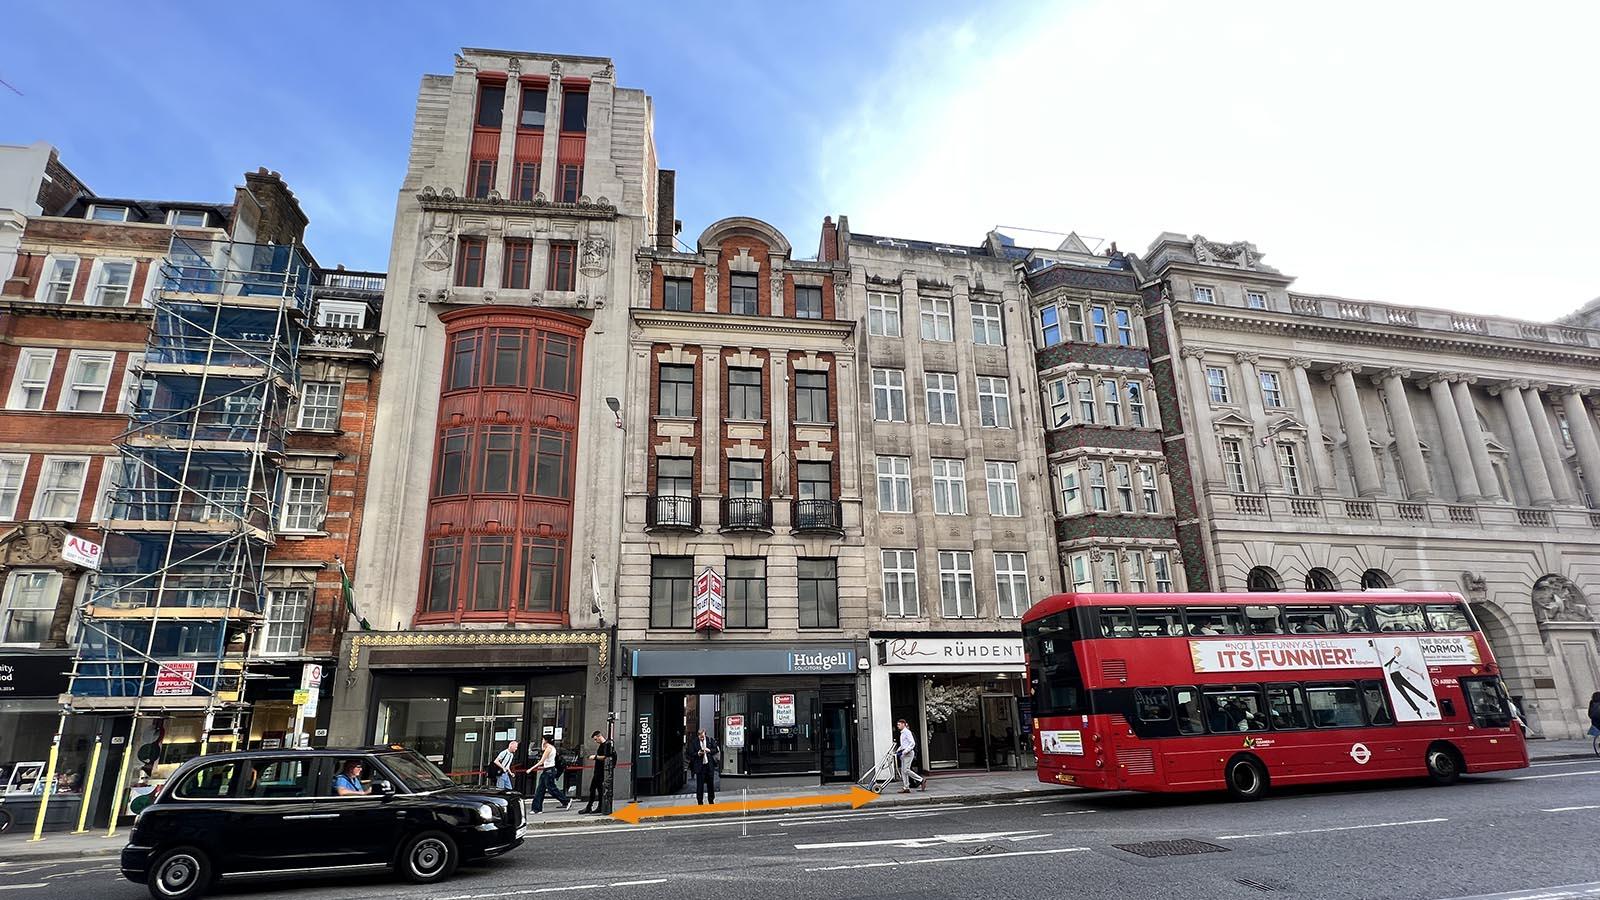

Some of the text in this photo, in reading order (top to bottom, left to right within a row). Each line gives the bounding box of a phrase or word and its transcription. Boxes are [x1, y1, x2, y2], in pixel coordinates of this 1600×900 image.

[68, 538, 98, 555] ALB
[1251, 642, 1269, 650] JUST
[1271, 641, 1300, 650] FUNNY
[1302, 641, 1313, 649] AS
[1421, 645, 1464, 653] MORMON
[794, 652, 847, 670] Hudgell
[640, 717, 652, 754] Hudgell
